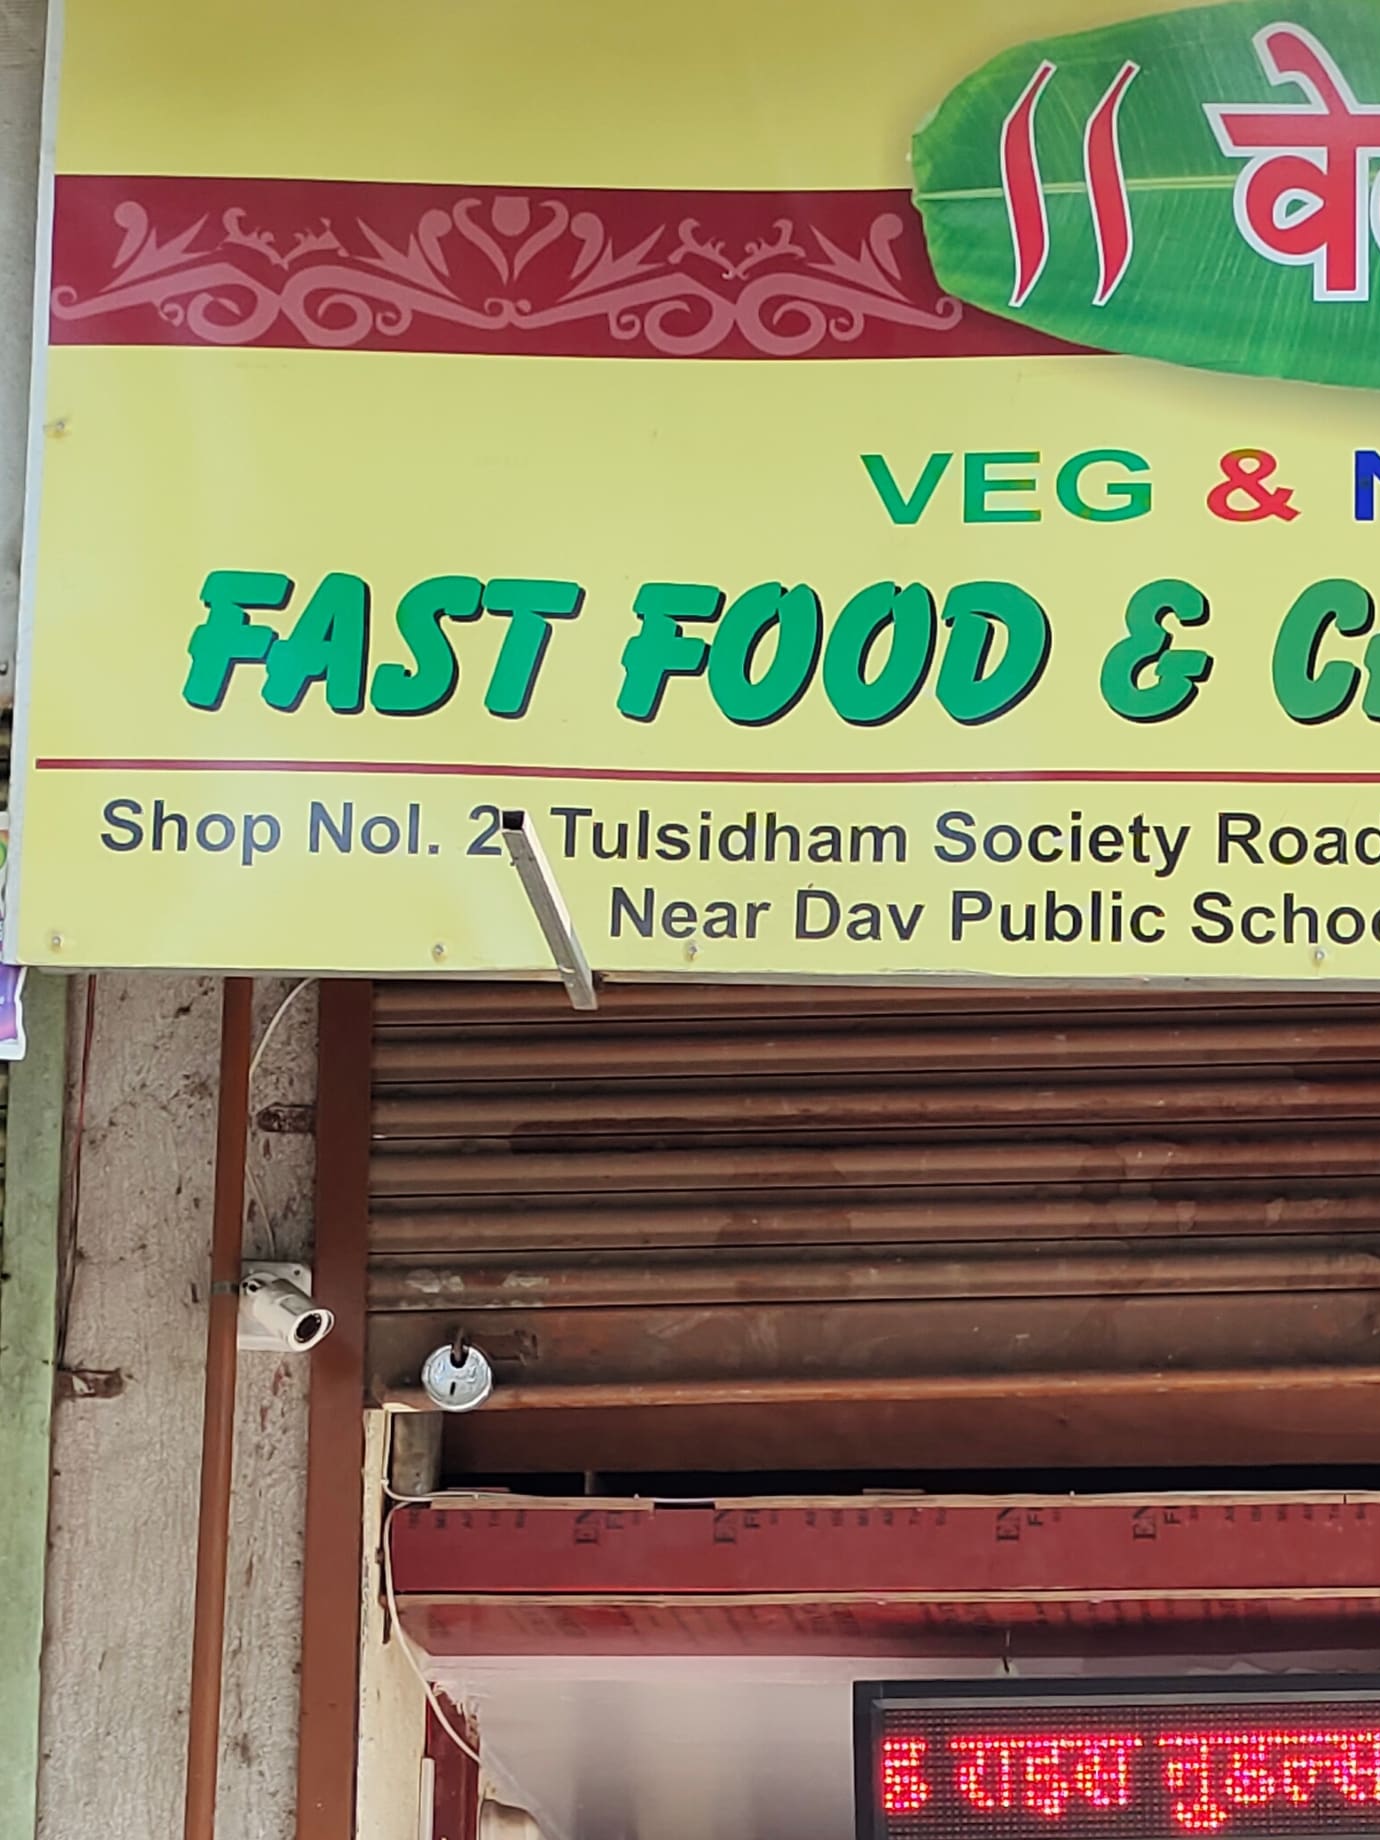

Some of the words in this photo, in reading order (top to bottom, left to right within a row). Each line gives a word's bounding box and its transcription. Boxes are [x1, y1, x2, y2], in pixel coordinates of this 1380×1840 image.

[860, 449, 1153, 524] VEG
[1206, 448, 1302, 523] &
[182, 570, 587, 722] FAST
[616, 580, 1054, 730] FOOD
[1099, 578, 1217, 726] &
[101, 799, 281, 867] Shop
[308, 802, 440, 855] Nol.
[550, 807, 908, 864] Tulsidham
[934, 811, 1192, 878] Society
[609, 886, 772, 940] Near
[795, 886, 925, 942] Dav
[951, 889, 1166, 944] Public
